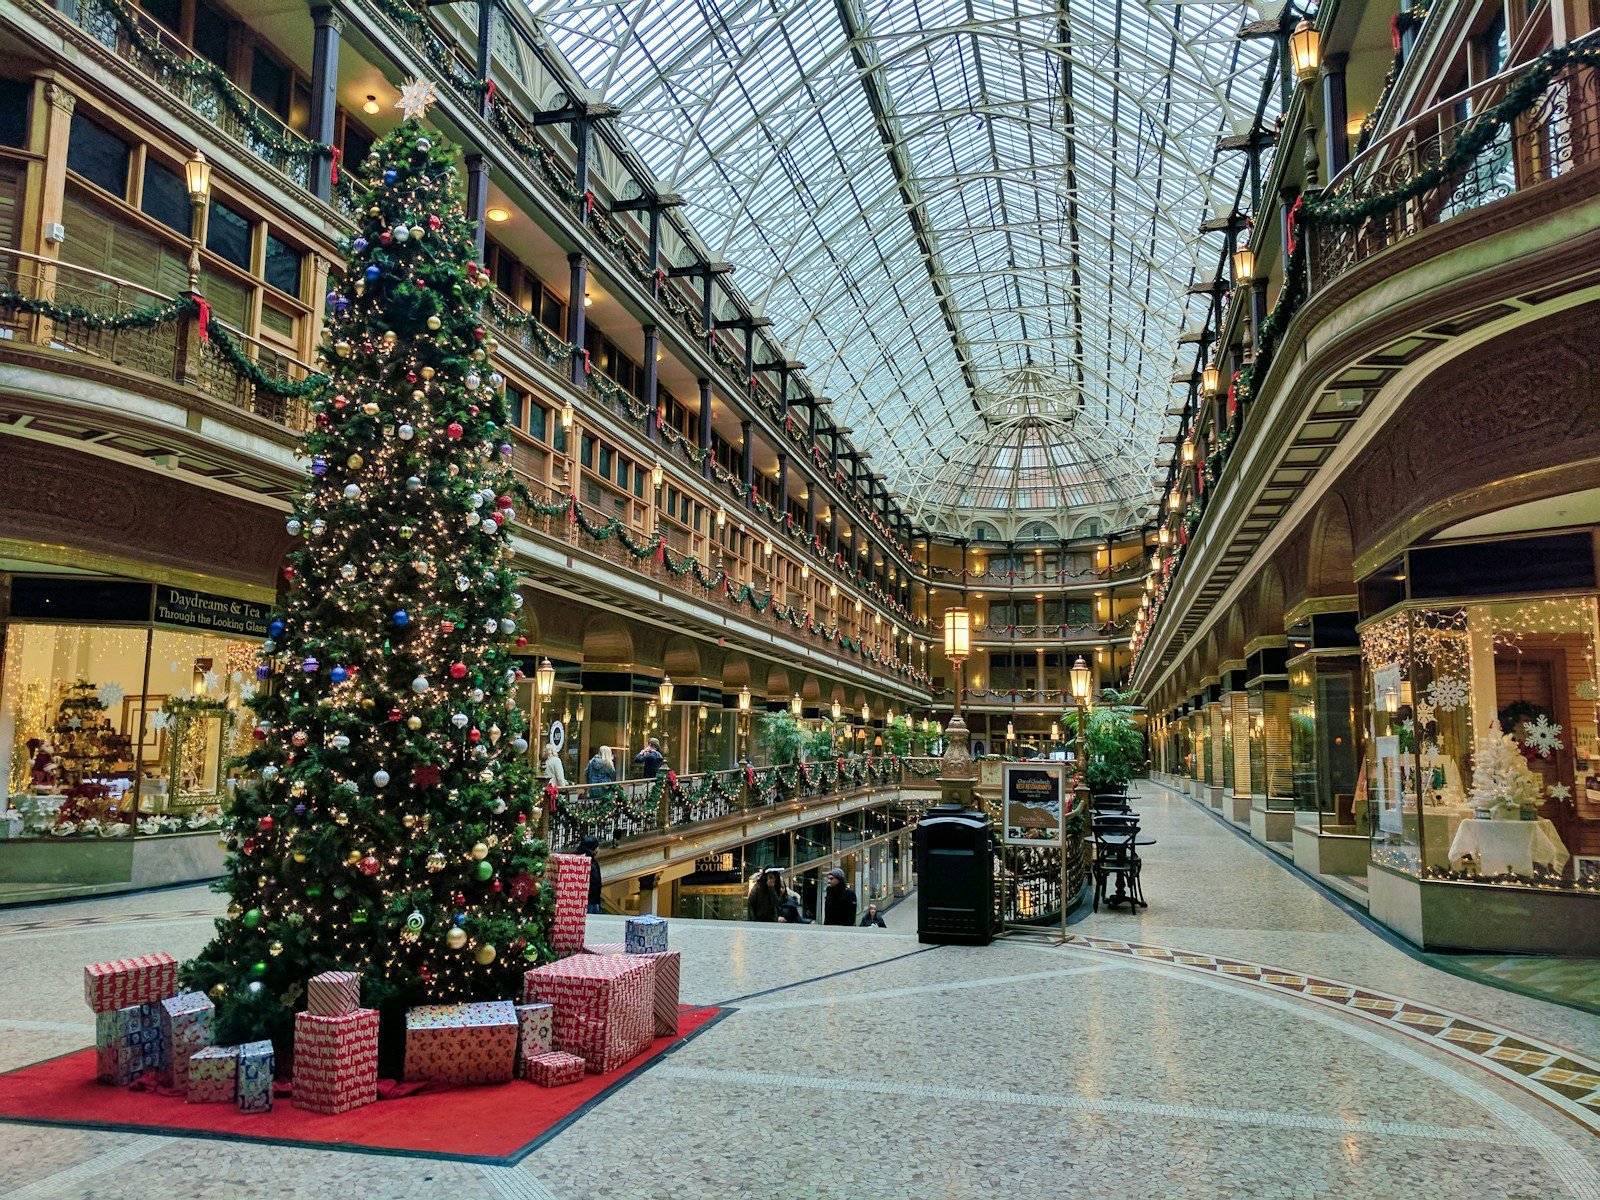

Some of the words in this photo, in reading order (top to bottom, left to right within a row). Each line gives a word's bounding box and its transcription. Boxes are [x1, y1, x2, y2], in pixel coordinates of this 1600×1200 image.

[170, 590, 228, 612] Daydreams
[230, 602, 240, 614] &
[243, 604, 260, 618] Tea
[159, 606, 196, 623] Through
[198, 614, 211, 624] the
[212, 615, 244, 632] Looking
[246, 621, 266, 634] Glass
